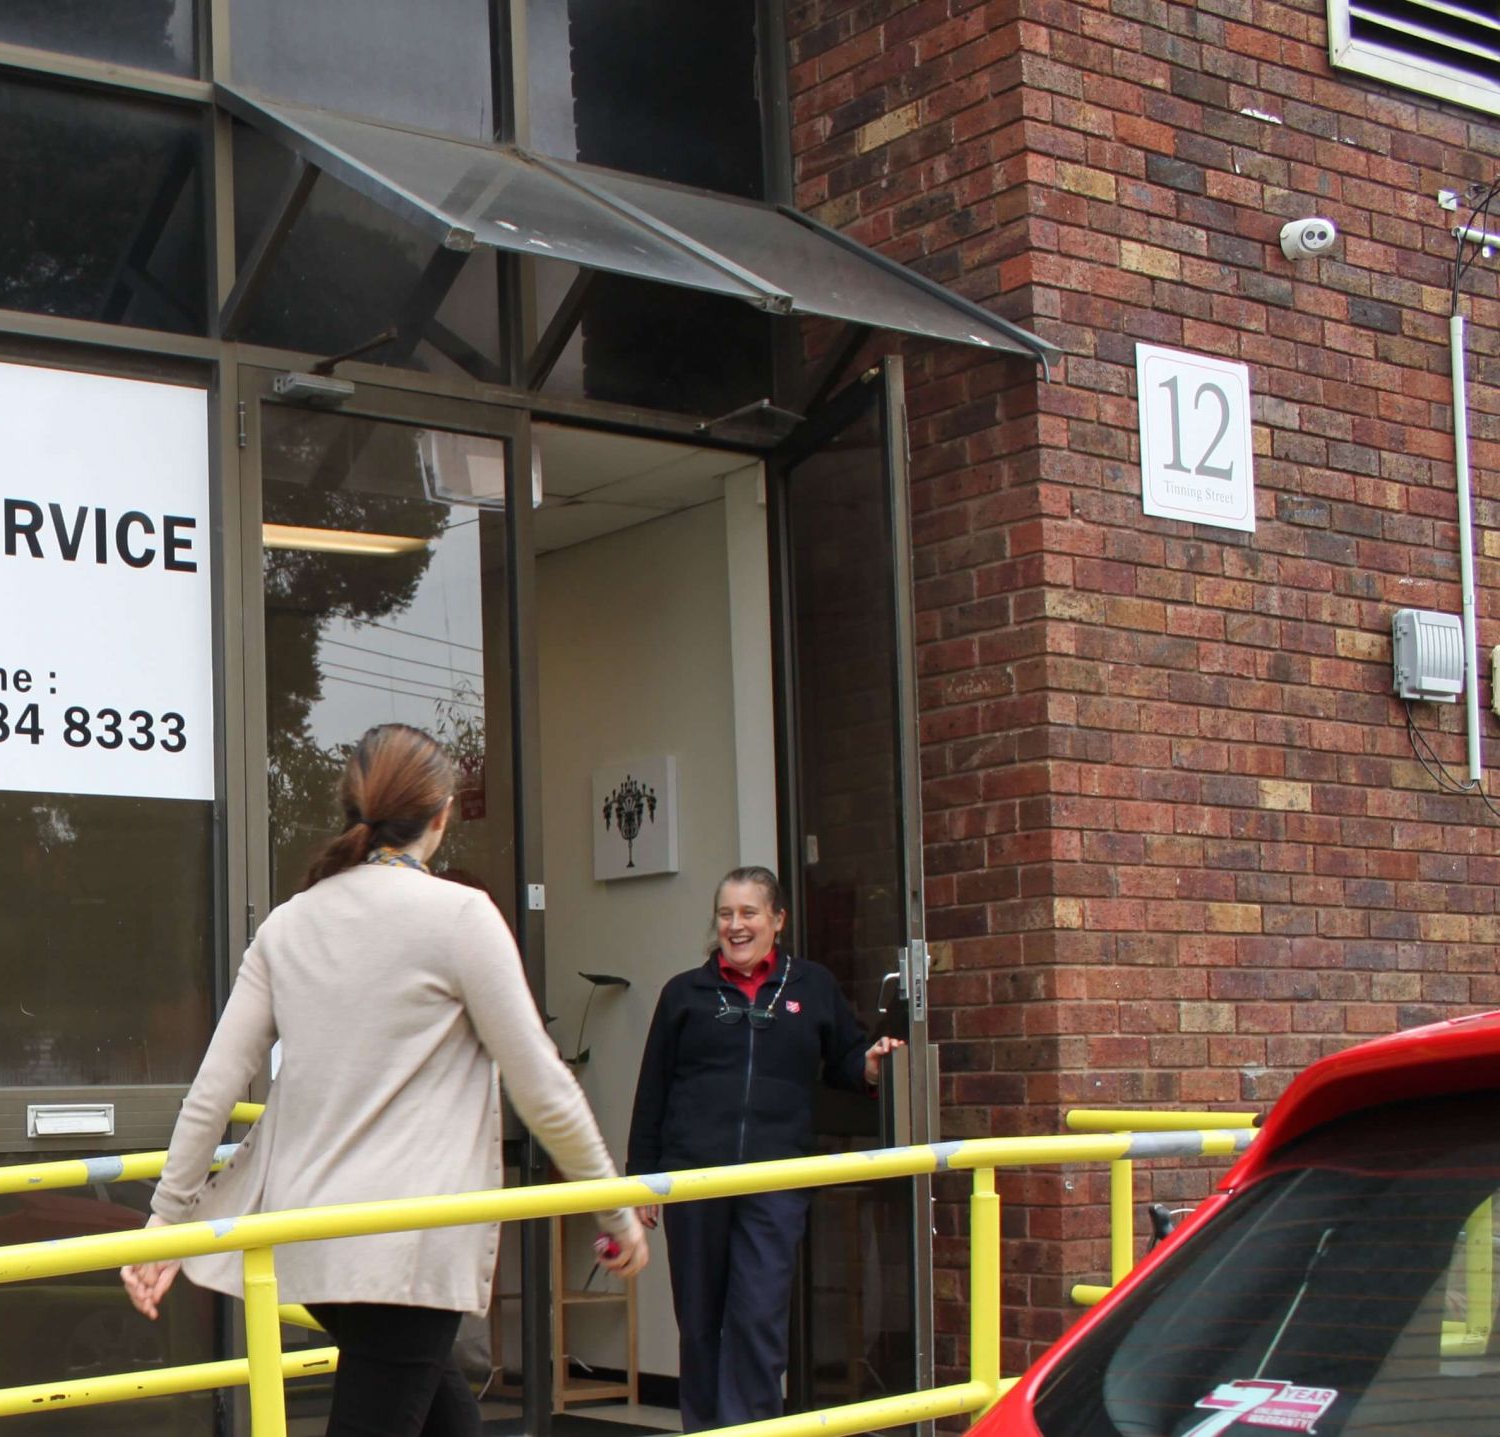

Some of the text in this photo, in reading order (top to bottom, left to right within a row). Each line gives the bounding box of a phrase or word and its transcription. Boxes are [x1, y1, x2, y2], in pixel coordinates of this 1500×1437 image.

[1158, 375, 1235, 481] 12
[1164, 480, 1234, 504] Tinning Street
[64, 707, 186, 752] 8333
[1284, 1388, 1333, 1402] YEAR
